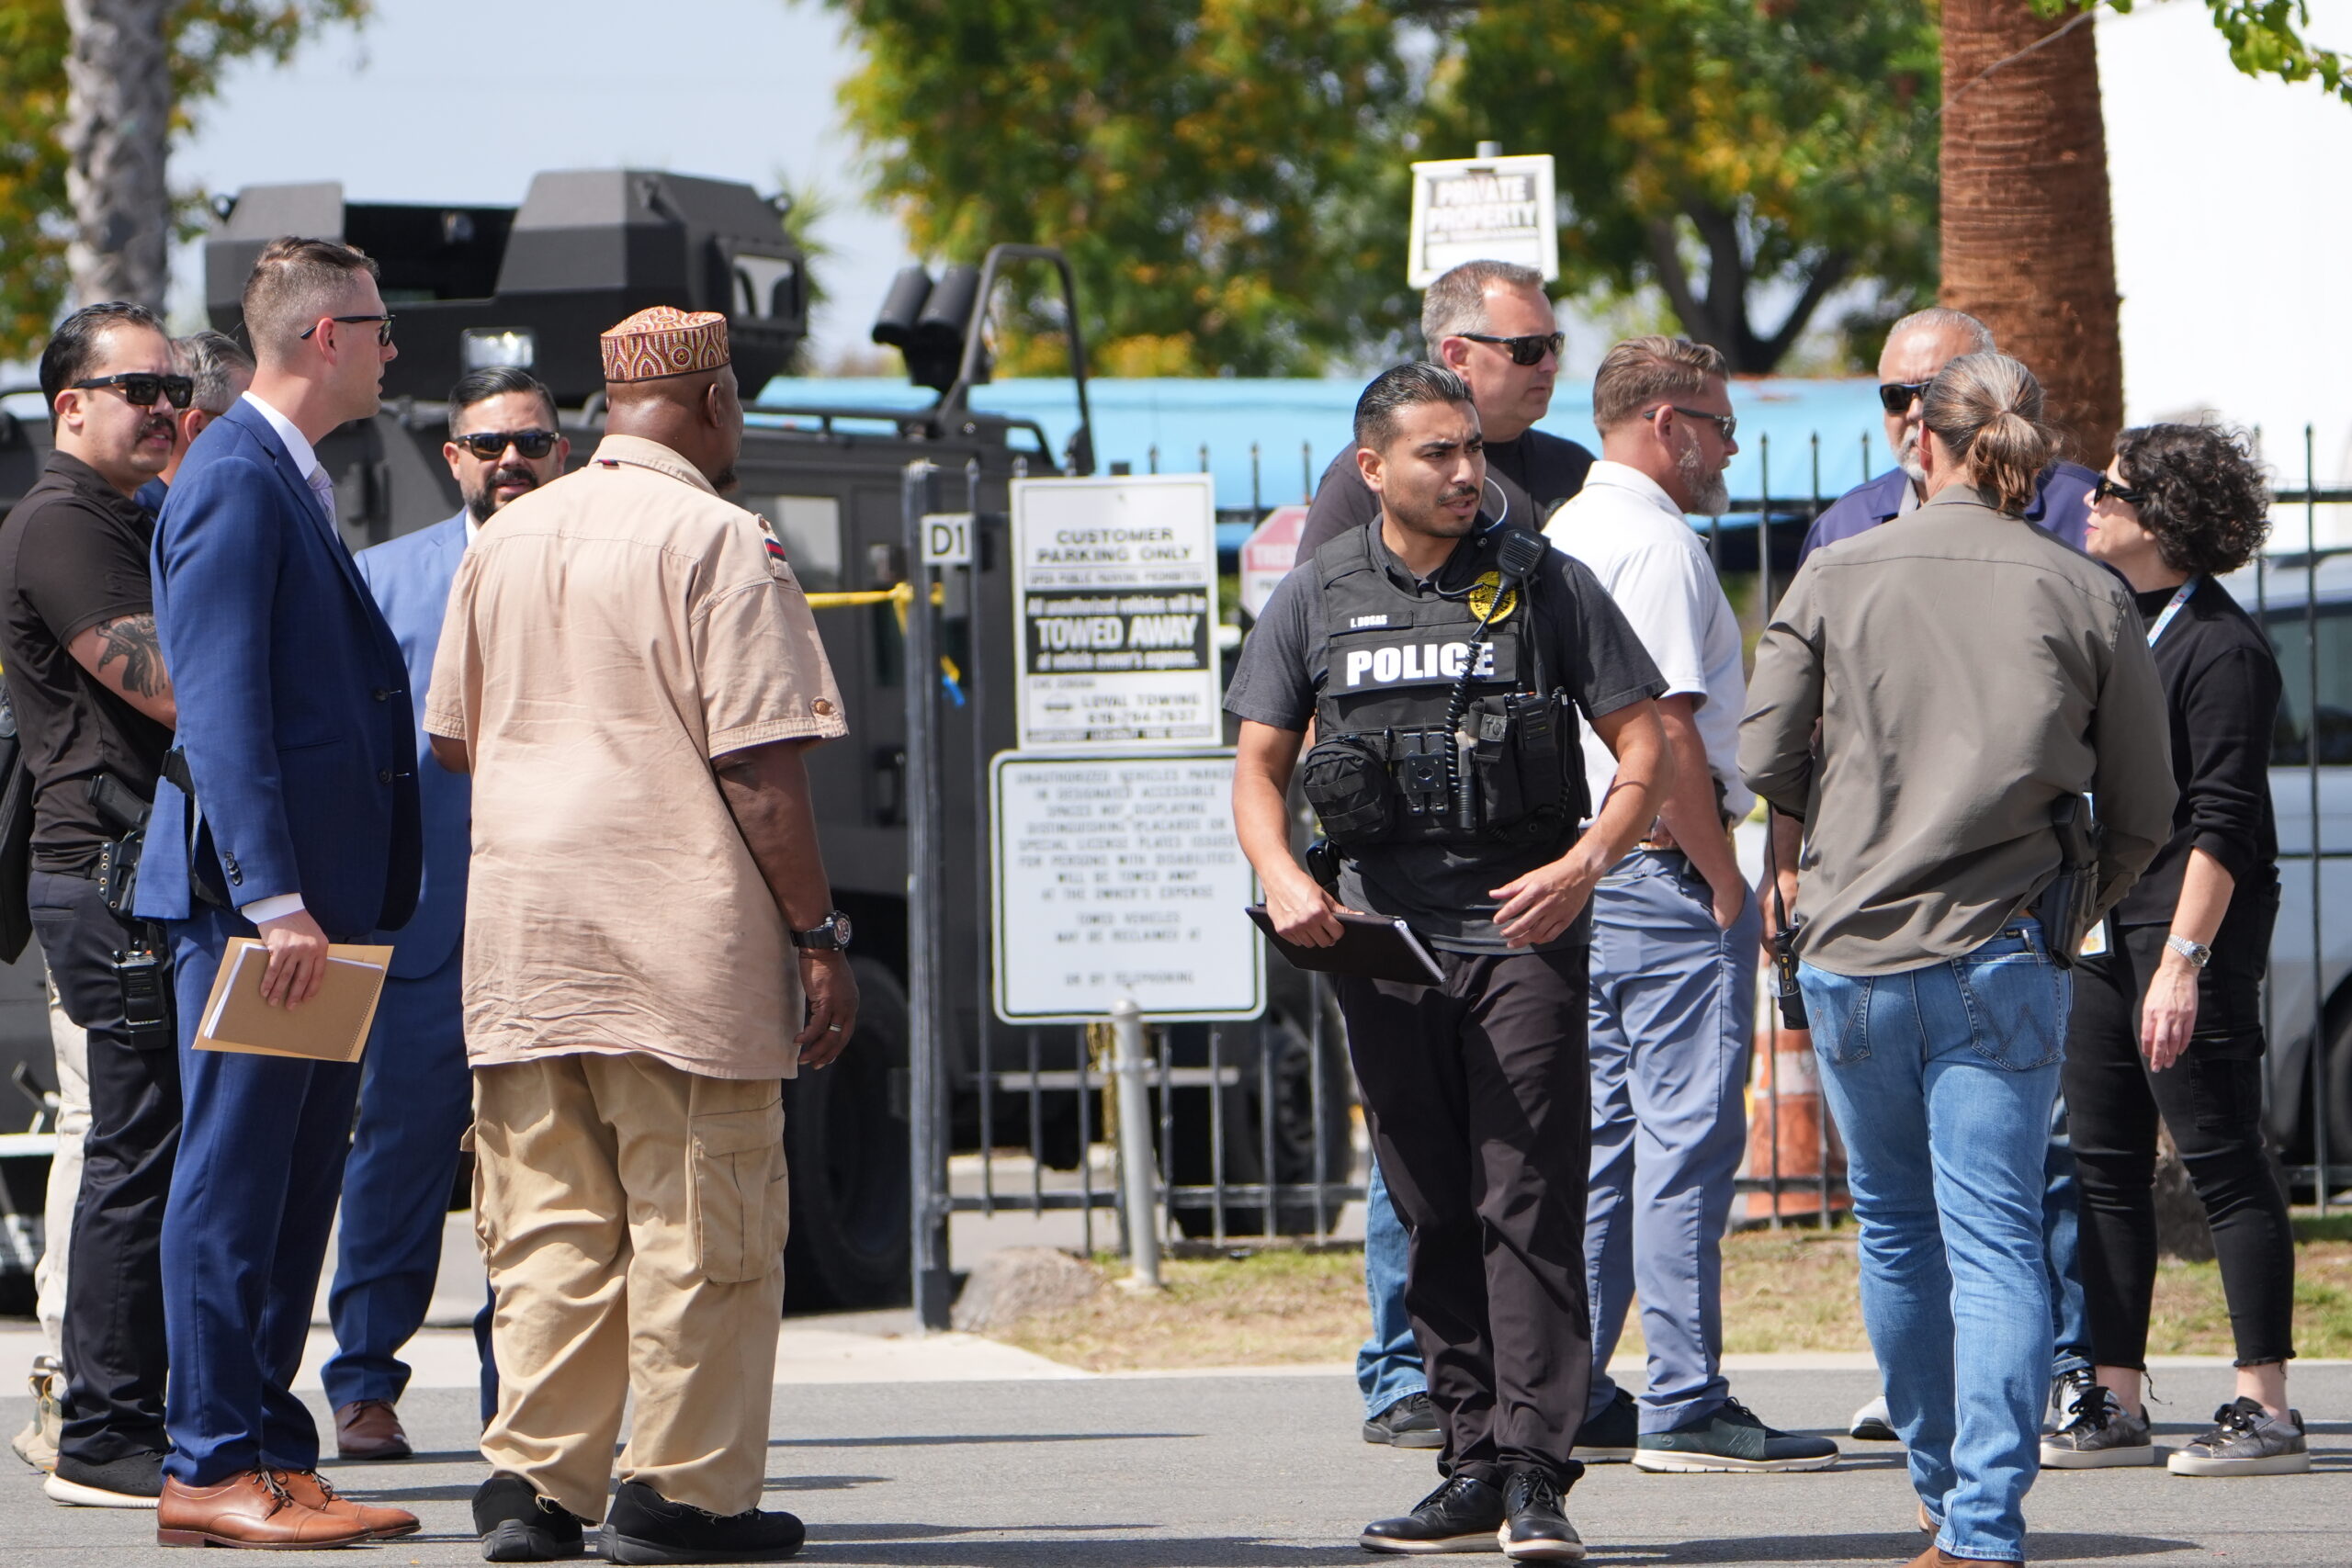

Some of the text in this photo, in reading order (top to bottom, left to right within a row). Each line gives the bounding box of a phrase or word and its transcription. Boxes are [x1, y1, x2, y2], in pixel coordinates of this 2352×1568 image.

[1438, 176, 1525, 206] PRIVATE
[1426, 202, 1537, 231] PROPERTY
[932, 524, 965, 556] D1
[1057, 527, 1174, 545] CUSTOMER
[1037, 546, 1192, 563] PARKING ONLY
[1045, 595, 1118, 615] unauthorized
[1119, 594, 1166, 615] vehicles
[1035, 614, 1199, 650] TOWED AWAY
[1347, 641, 1494, 686] POLICE
[1136, 693, 1201, 706] TOWING
[1016, 771, 1109, 784] UNAUTHORIZED
[1119, 770, 1179, 782] VEHICLES
